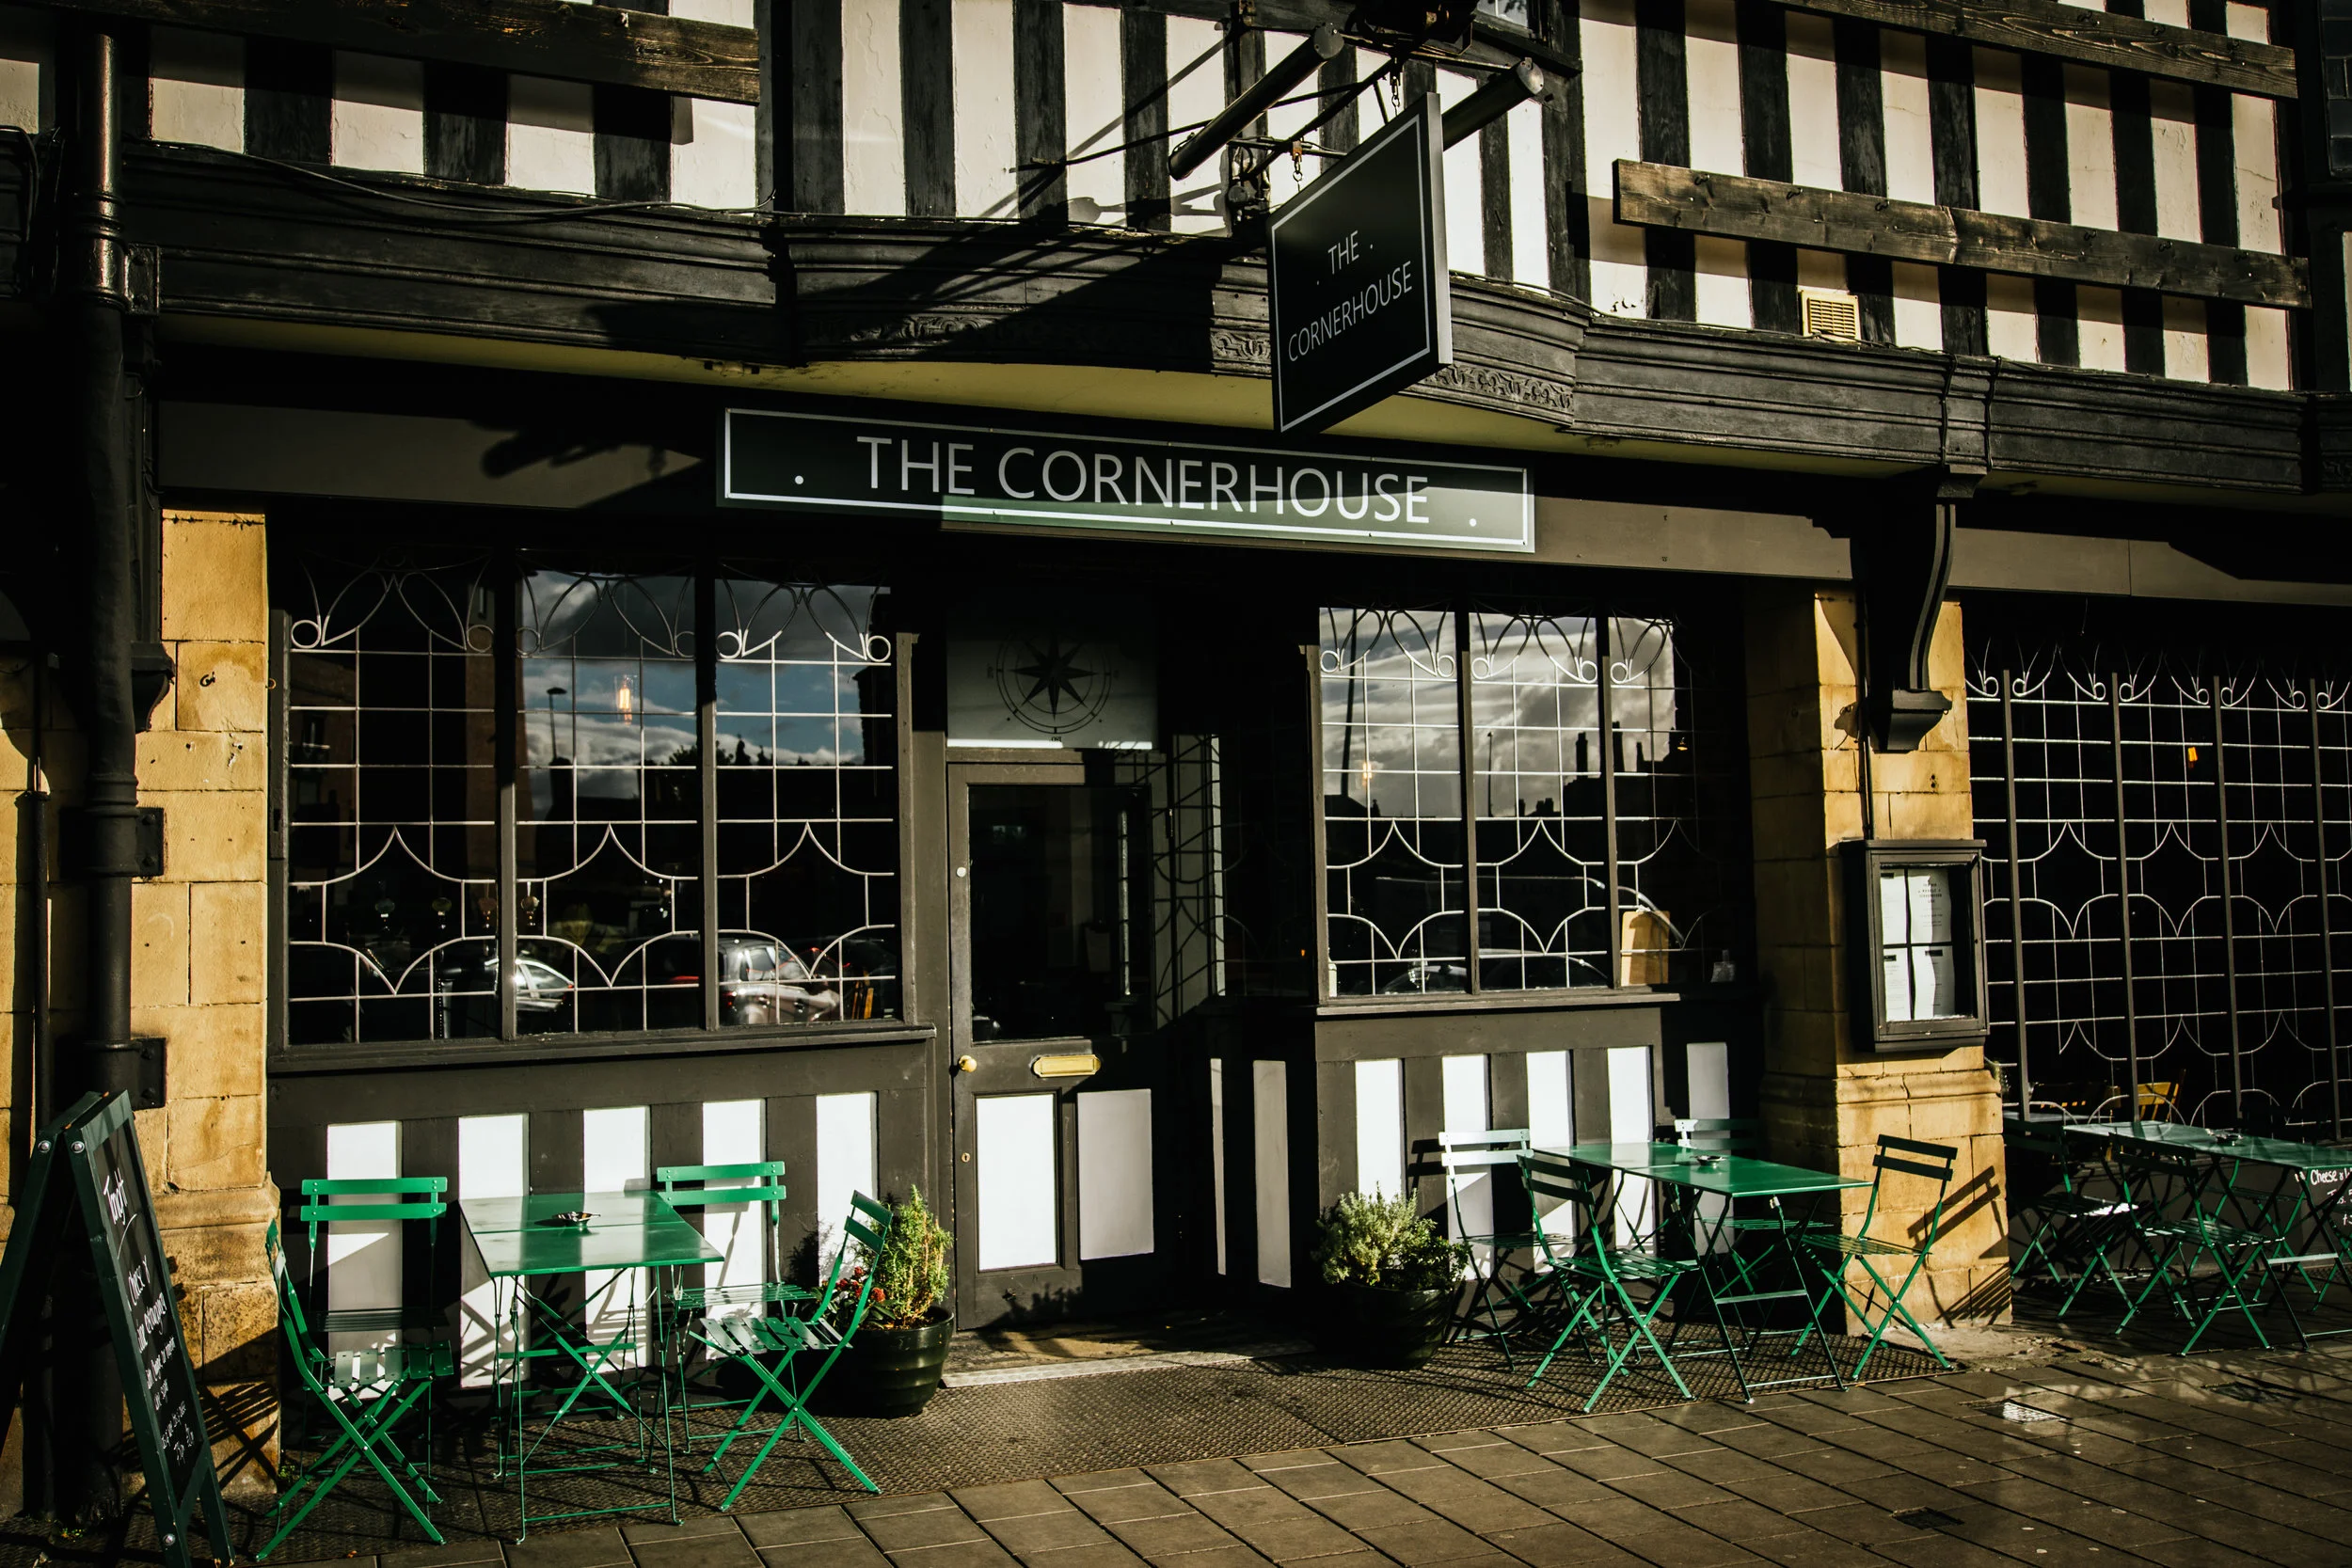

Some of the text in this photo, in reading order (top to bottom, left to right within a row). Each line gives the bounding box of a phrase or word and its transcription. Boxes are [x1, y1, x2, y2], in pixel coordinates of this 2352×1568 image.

[1327, 230, 1360, 276] THE
[1288, 261, 1413, 362] CORNERHOUSE
[856, 435, 1430, 524] THE CORNERHOUSE
[2311, 1169, 2338, 1185] Cheese
